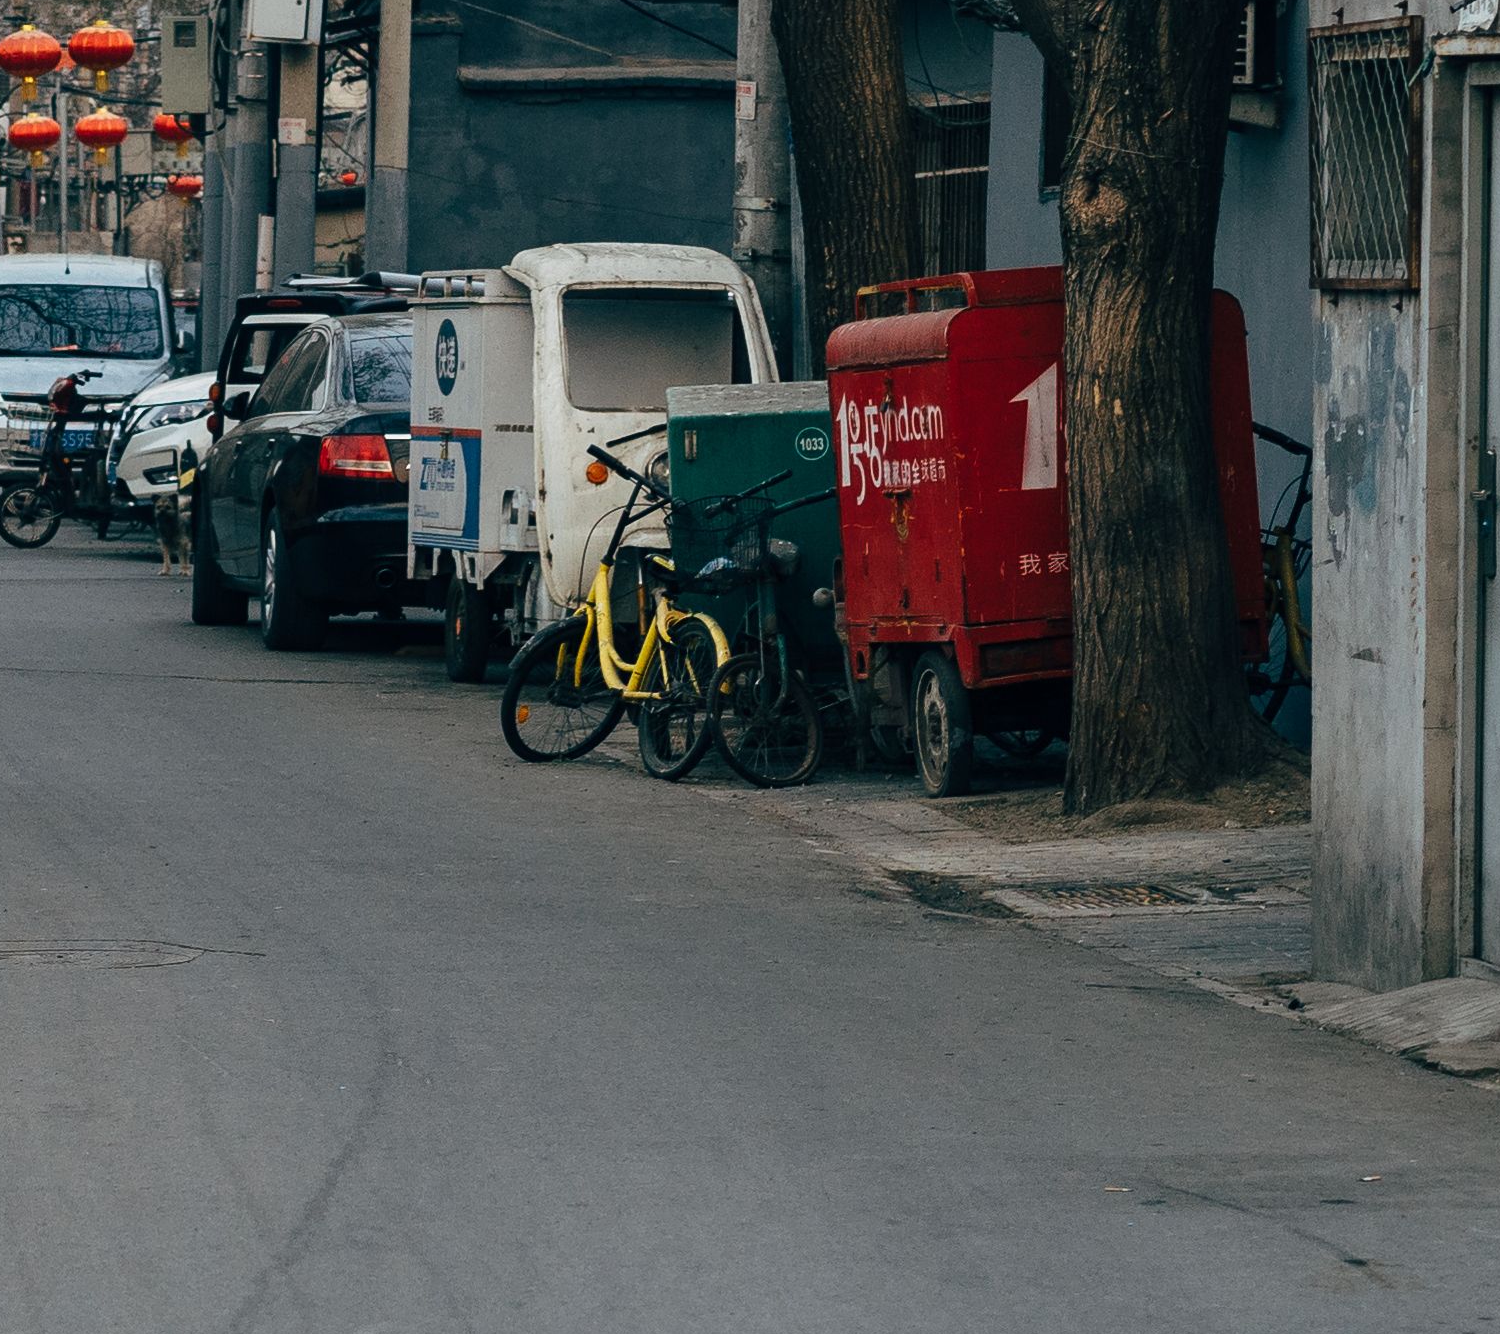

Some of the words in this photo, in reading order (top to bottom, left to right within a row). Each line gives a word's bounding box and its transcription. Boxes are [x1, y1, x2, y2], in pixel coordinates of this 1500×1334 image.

[438, 334, 456, 379] 快递
[799, 437, 825, 451] 1033
[1009, 362, 1057, 491] 1
[1018, 551, 1069, 576] 我家
